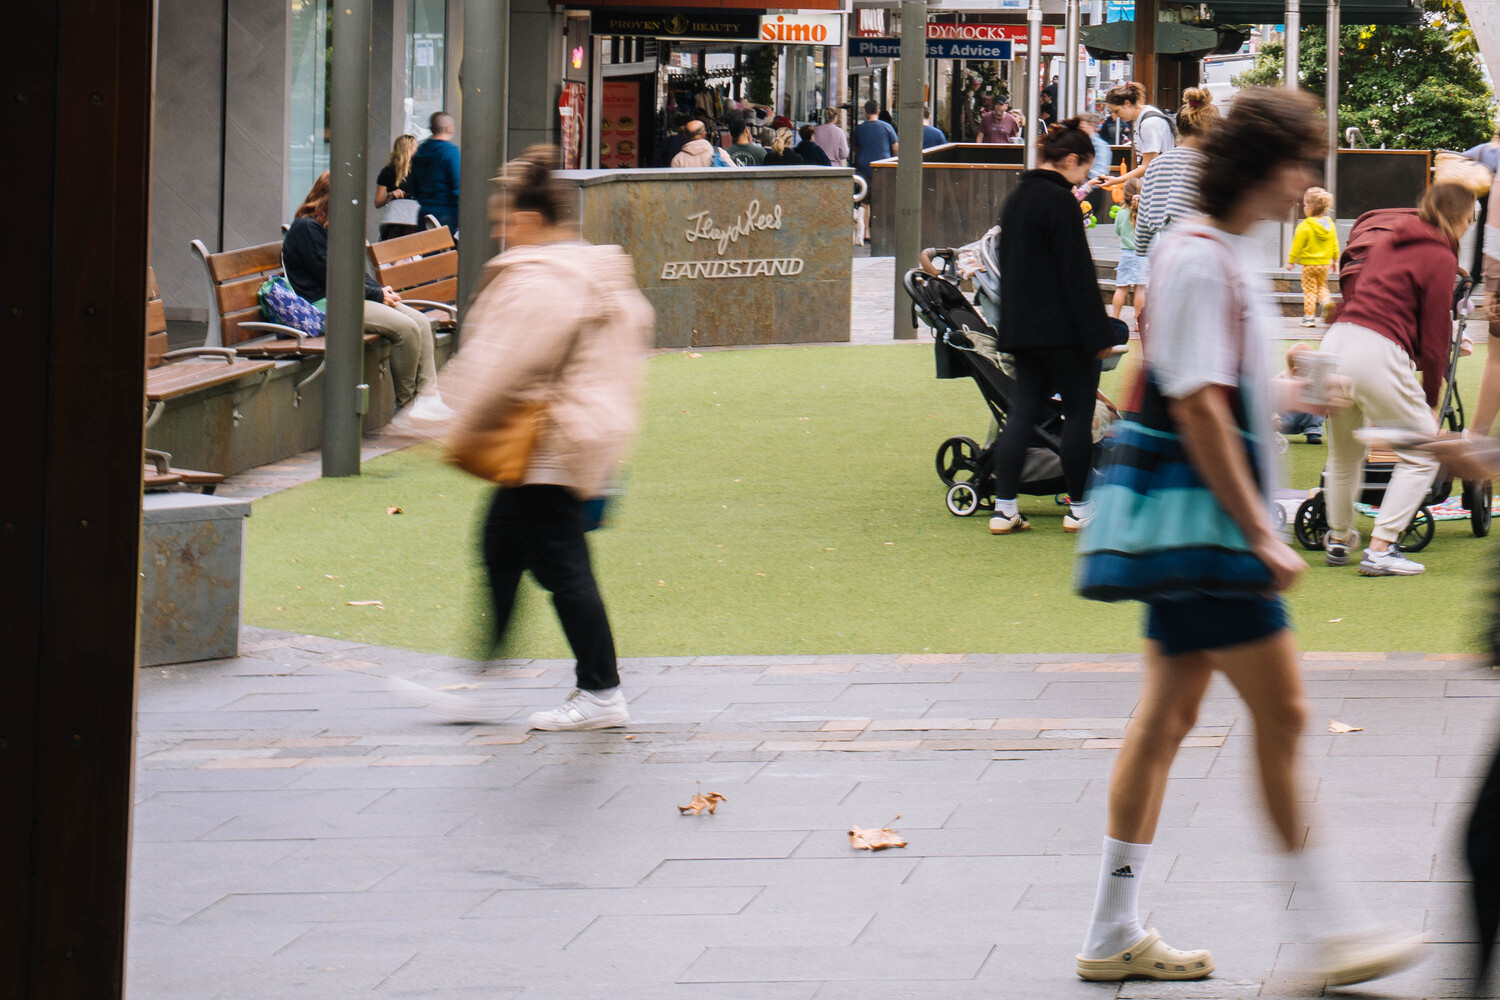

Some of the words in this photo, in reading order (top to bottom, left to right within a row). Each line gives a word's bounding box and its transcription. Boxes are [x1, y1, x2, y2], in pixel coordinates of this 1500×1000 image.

[609, 19, 660, 30] PROVEN
[692, 22, 741, 33] BEAUTY
[762, 15, 828, 42] simo
[928, 25, 1006, 40] DYMOCKS
[950, 44, 1001, 57] Advice
[660, 258, 804, 280] BANDSTAND
